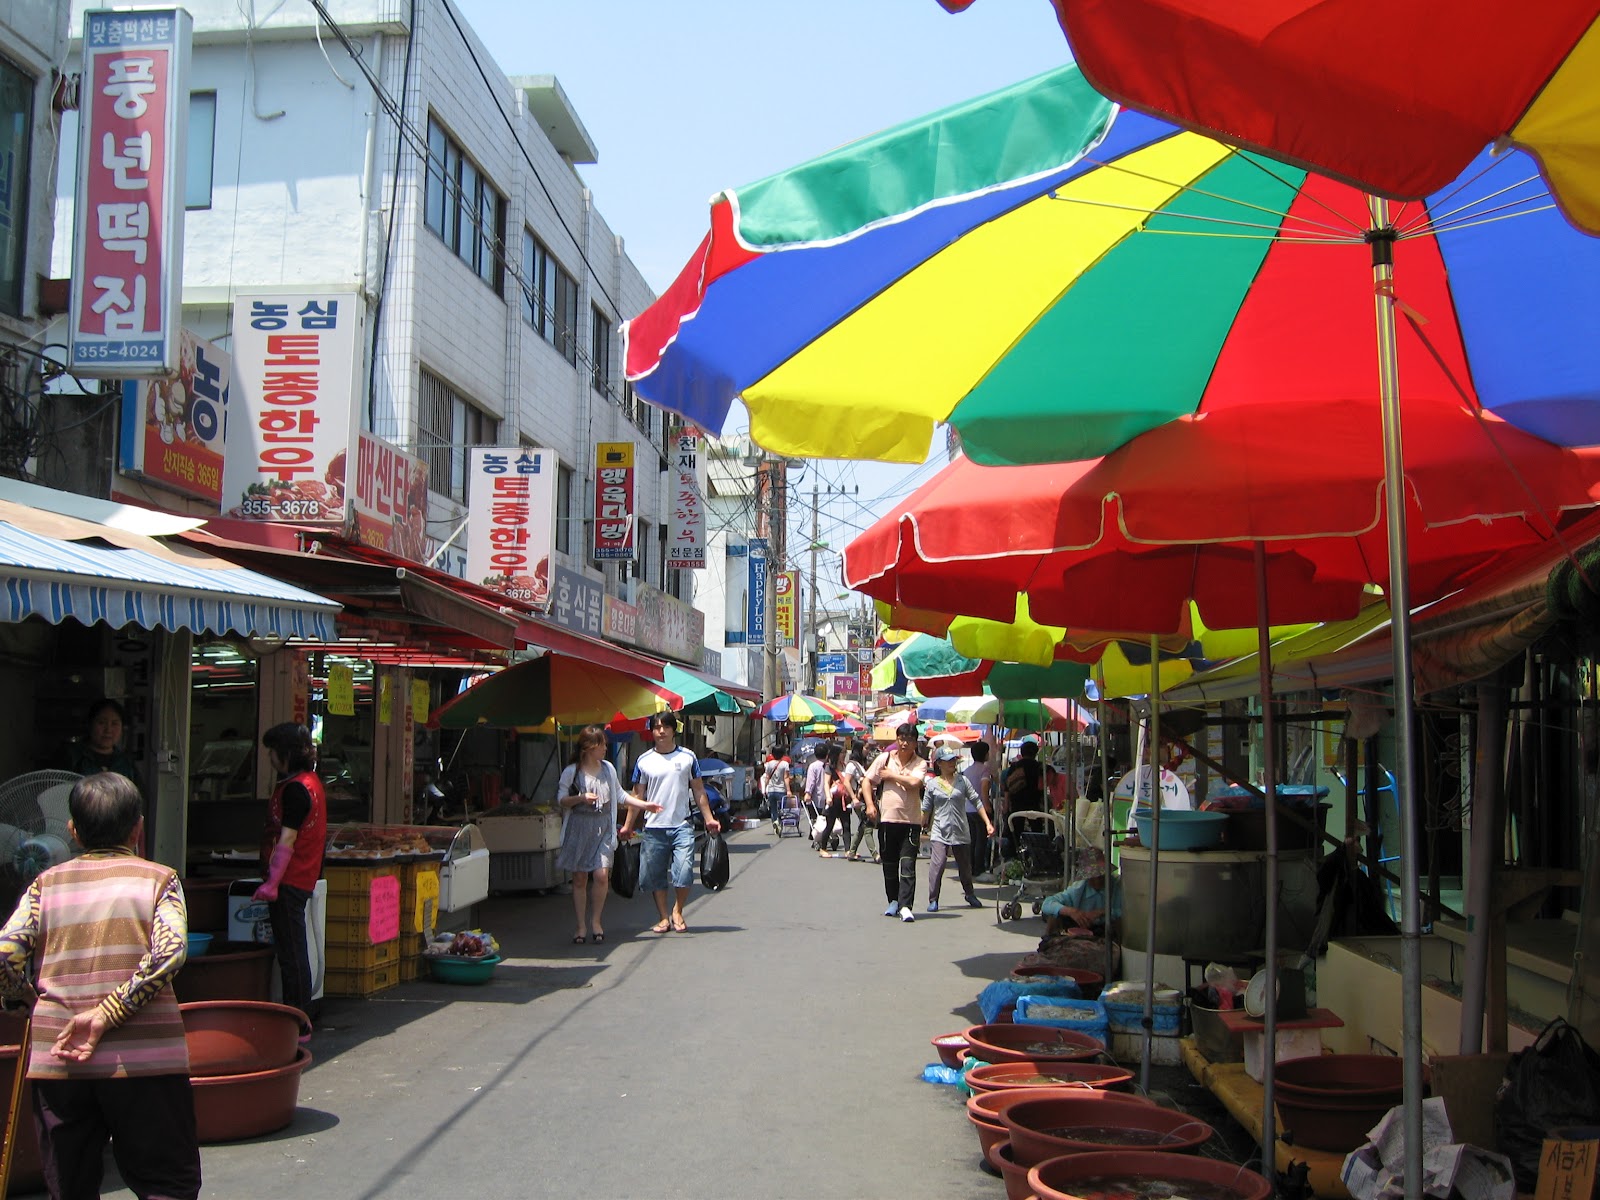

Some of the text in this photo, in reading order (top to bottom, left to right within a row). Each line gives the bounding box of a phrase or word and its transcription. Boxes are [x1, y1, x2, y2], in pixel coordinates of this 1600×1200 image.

[91, 57, 157, 338] 풍년떡집
[250, 300, 338, 331] 농심
[78, 345, 159, 358] 355-4024
[258, 334, 321, 482] 토종한우
[482, 453, 542, 474] 농심
[242, 500, 320, 515] 355-3678
[489, 476, 531, 577] 토종한우
[600, 468, 630, 540] 행운다방
